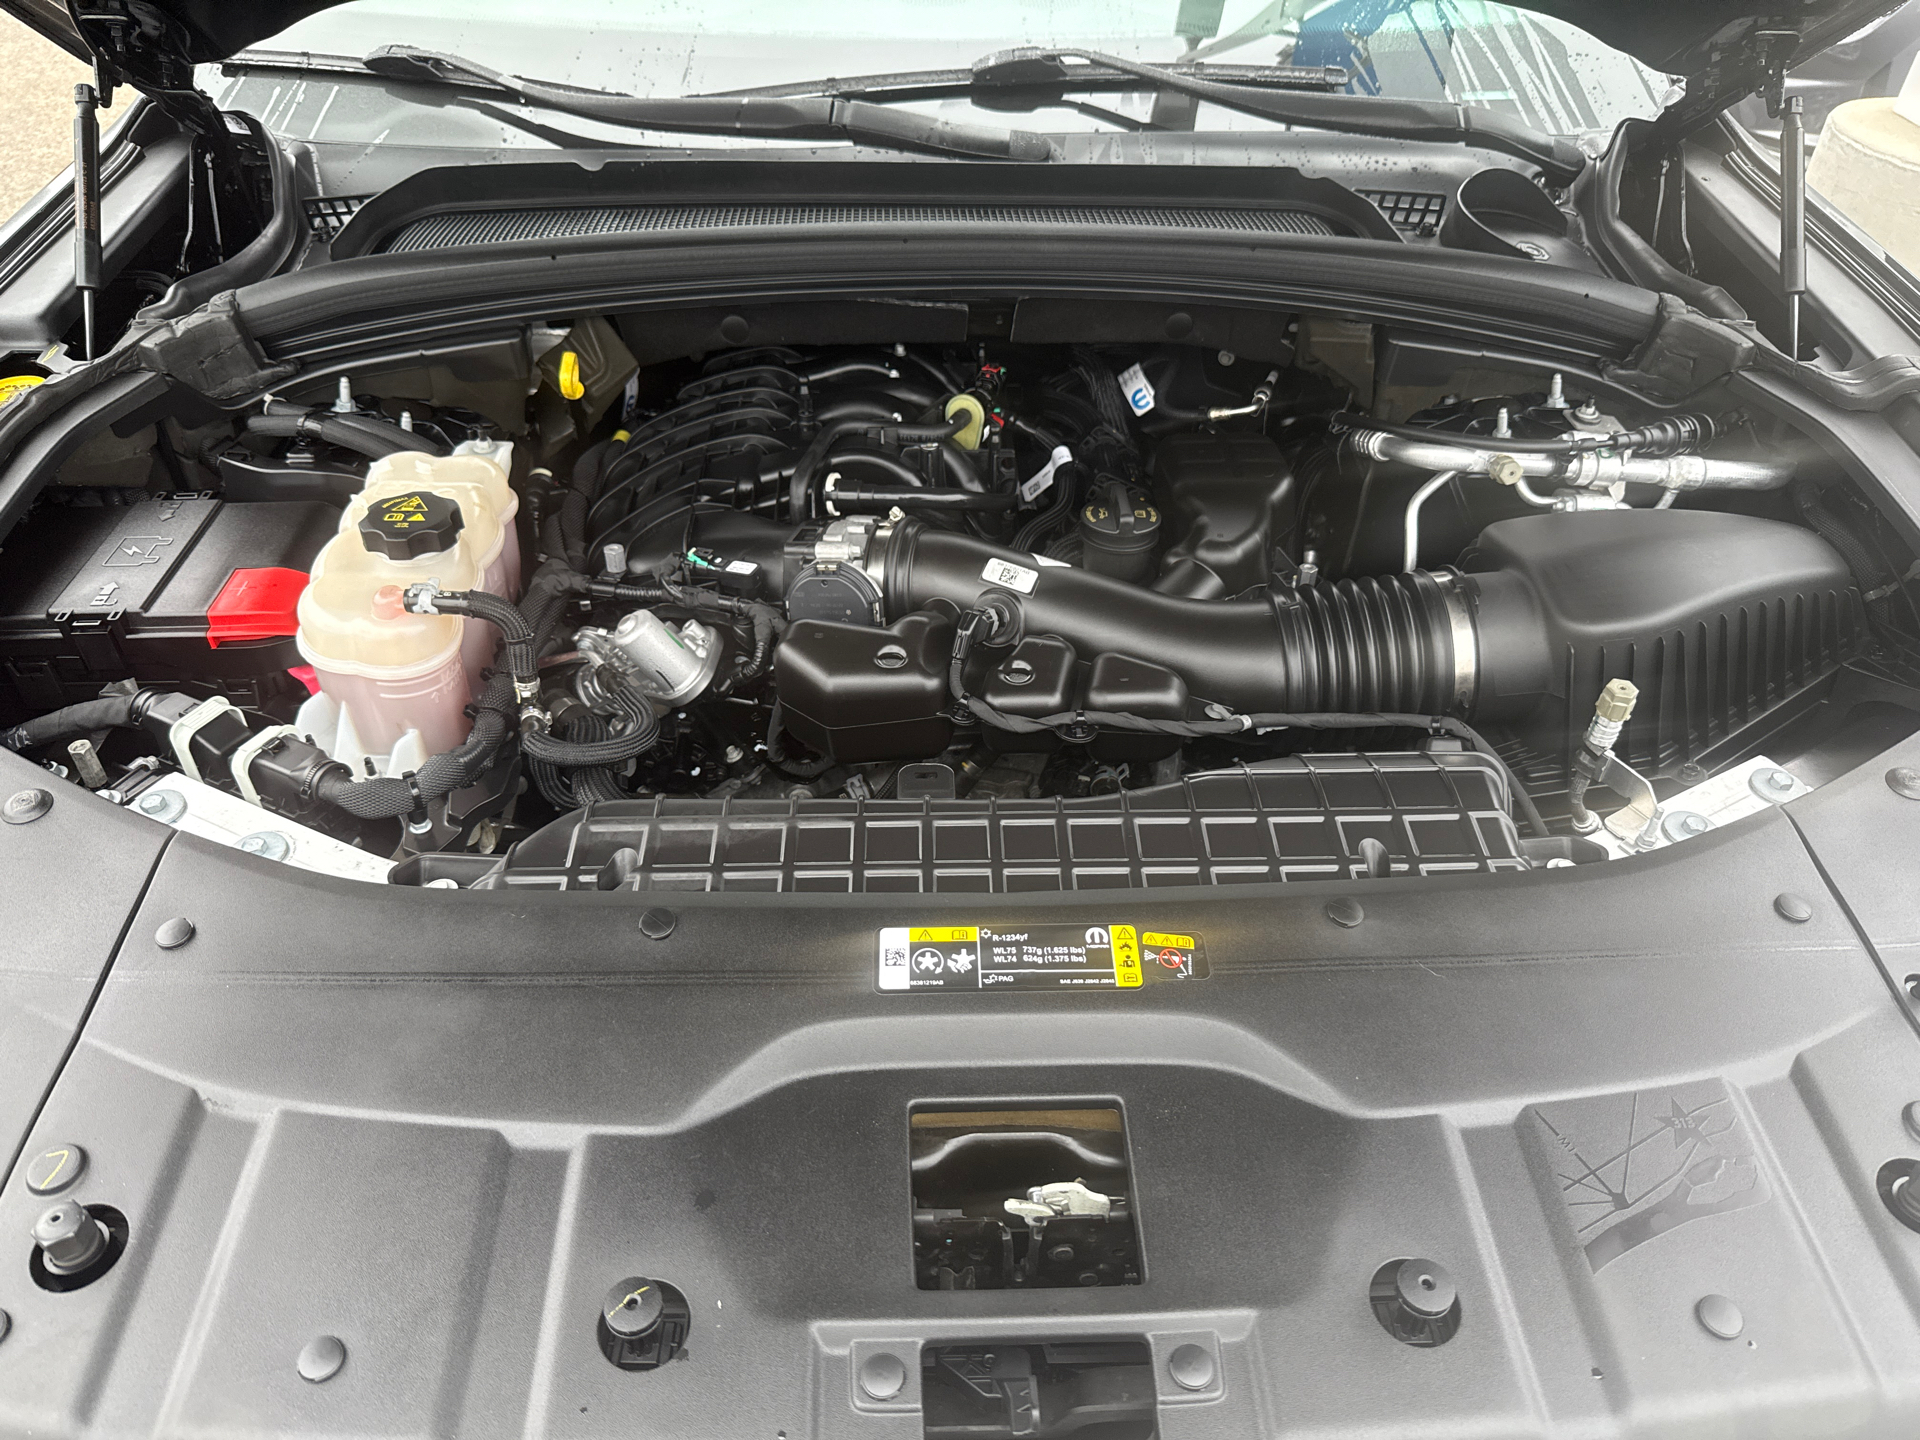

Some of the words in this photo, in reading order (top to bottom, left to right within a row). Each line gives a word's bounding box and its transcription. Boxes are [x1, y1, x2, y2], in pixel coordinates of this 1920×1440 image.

[992, 933, 1028, 942] R-1234yf
[1022, 946, 1043, 955] 737g
[1044, 946, 1068, 955] (1.625
[1070, 946, 1086, 955] lbs)
[993, 955, 1017, 963] WL74
[1022, 955, 1043, 964] 624g
[1044, 955, 1069, 963] (1.375
[1071, 955, 1087, 963] lbs)
[1671, 1117, 1696, 1129] 313
